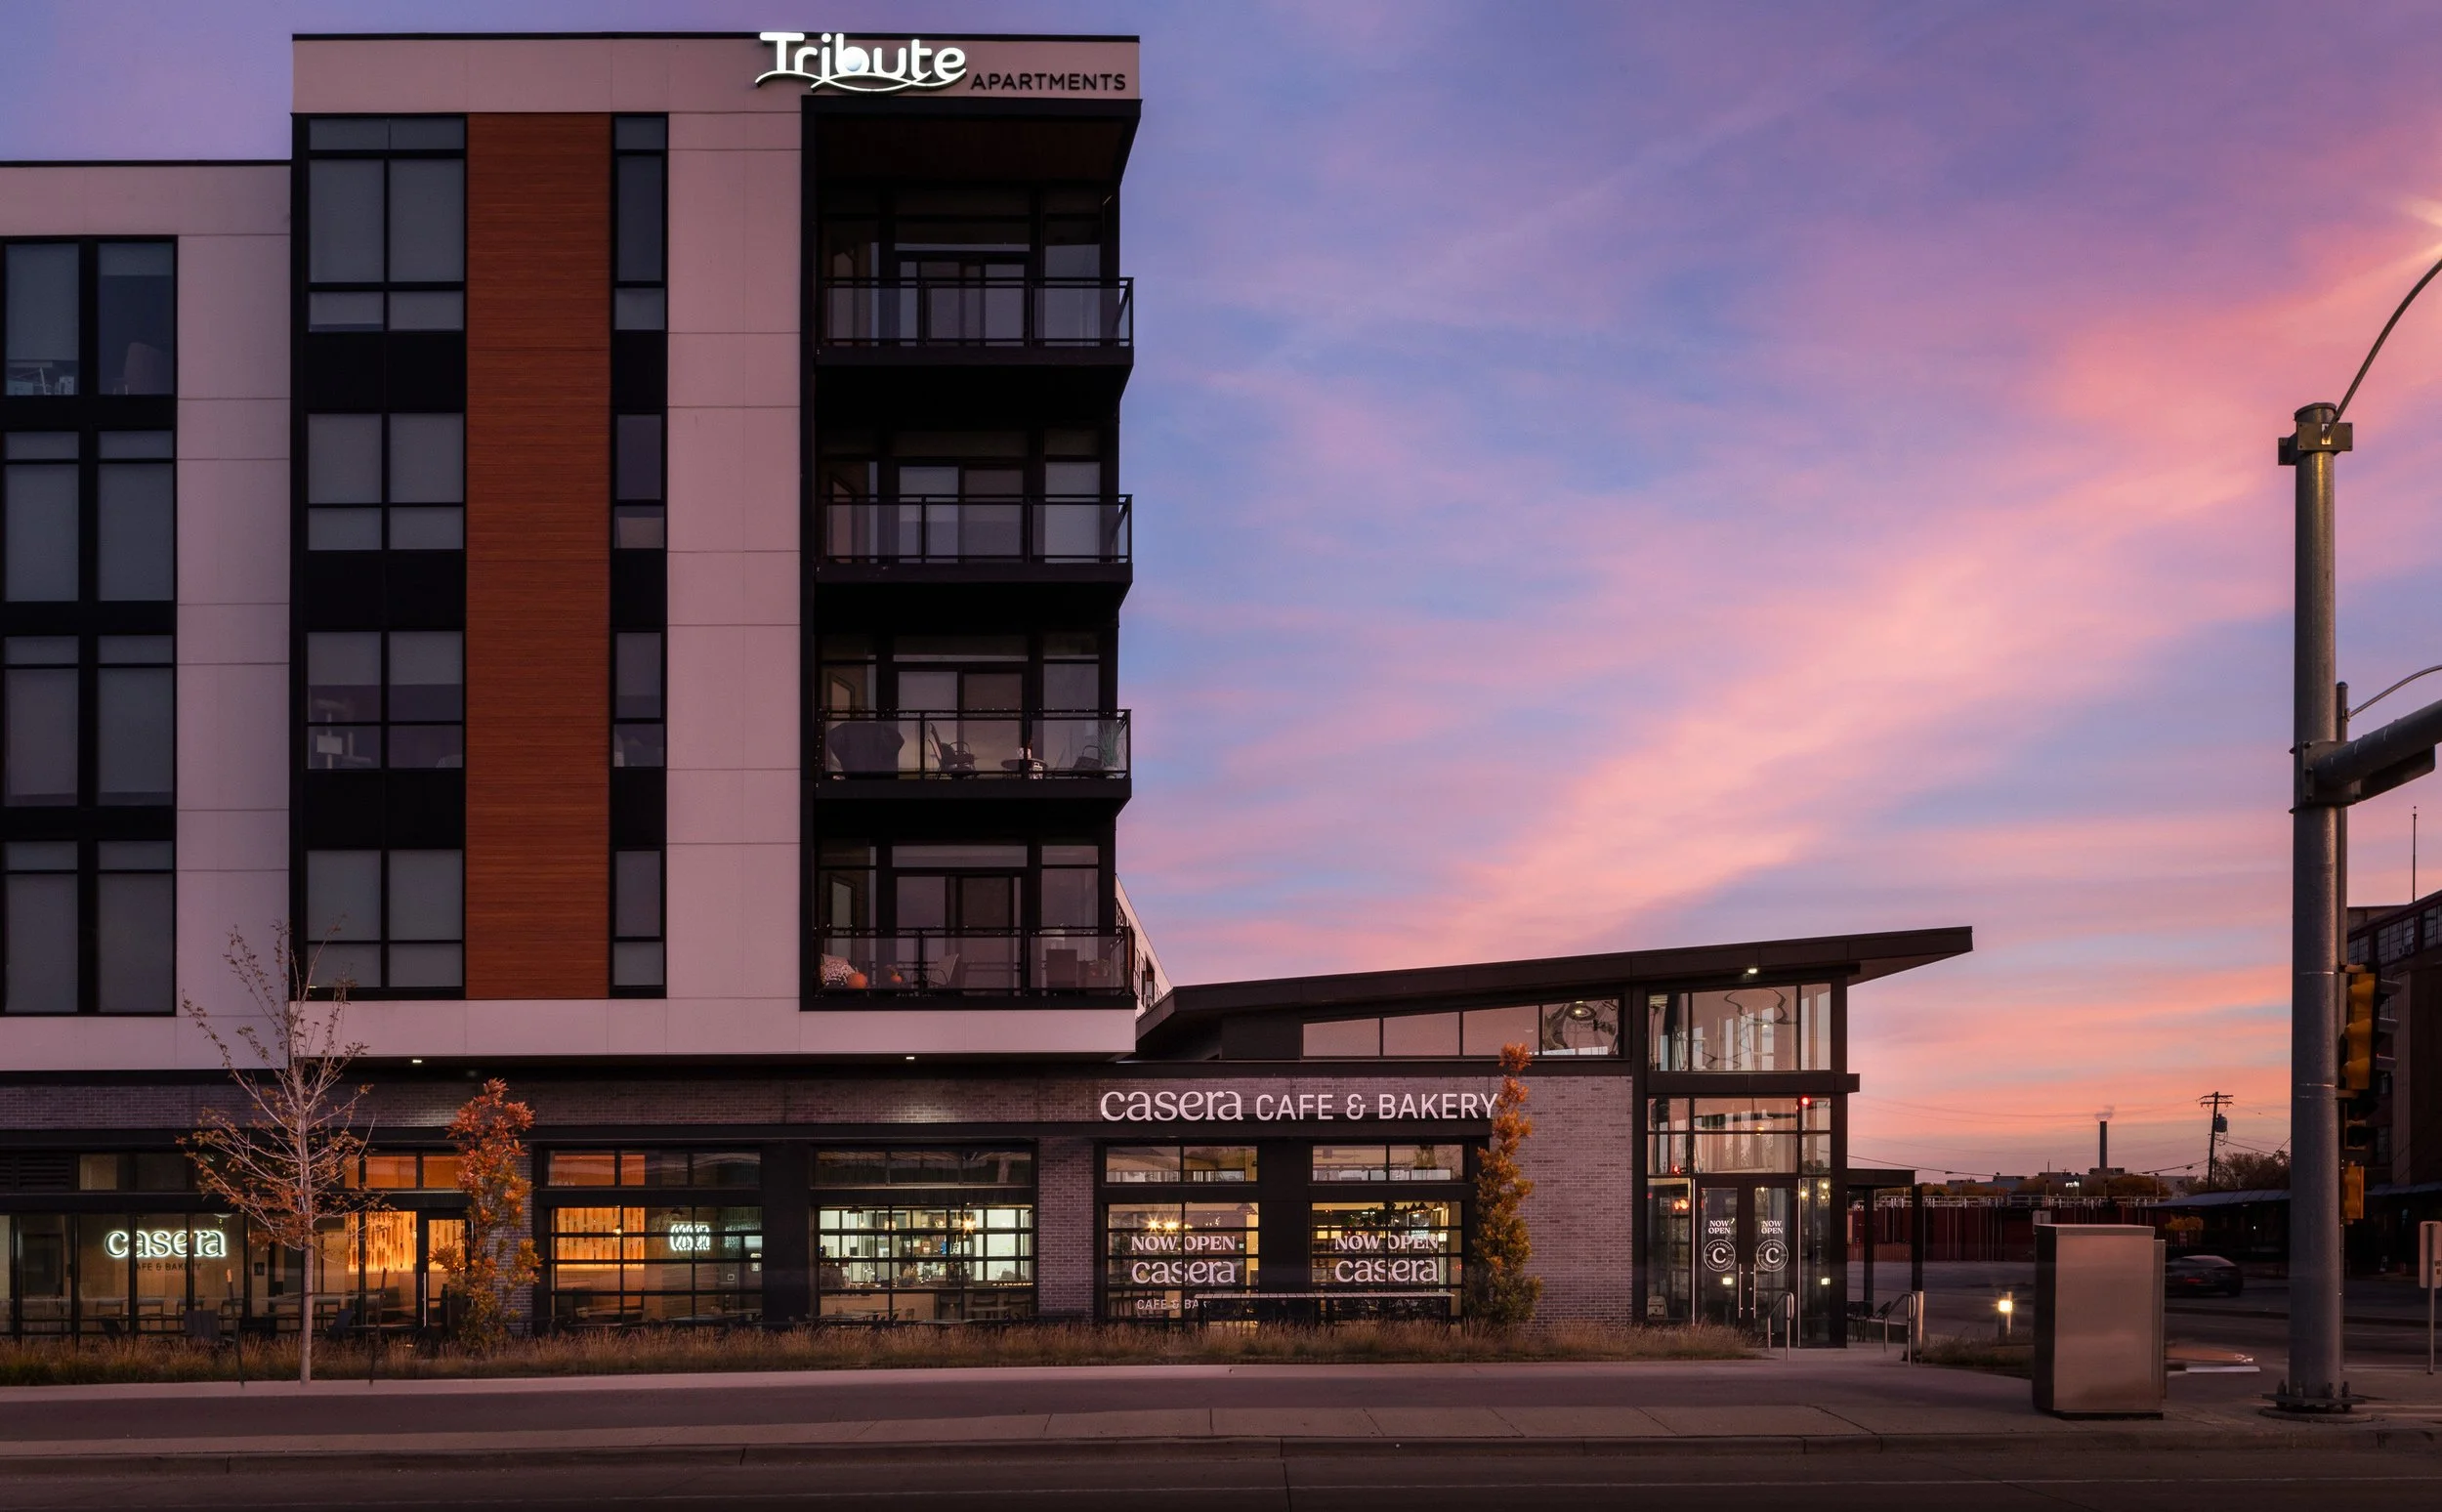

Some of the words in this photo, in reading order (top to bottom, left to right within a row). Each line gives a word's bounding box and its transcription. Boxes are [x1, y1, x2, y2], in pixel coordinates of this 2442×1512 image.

[759, 31, 966, 85] Tribute
[970, 72, 1126, 91] APARTMENTS
[1100, 1091, 1244, 1121] casera
[1255, 1094, 1334, 1121] CAFE
[1346, 1093, 1367, 1120] &
[1378, 1093, 1498, 1120] BAKERY
[105, 1230, 227, 1258] casera
[1131, 1236, 1178, 1251] NOW
[1184, 1236, 1236, 1251] OPEN
[1334, 1235, 1381, 1250] NOW
[1387, 1235, 1439, 1249] OPEN
[1712, 1247, 1726, 1264] C
[1765, 1247, 1779, 1264] C
[1131, 1261, 1237, 1284] casera
[1334, 1260, 1439, 1282] casera
[1136, 1299, 1167, 1310] CAFE
